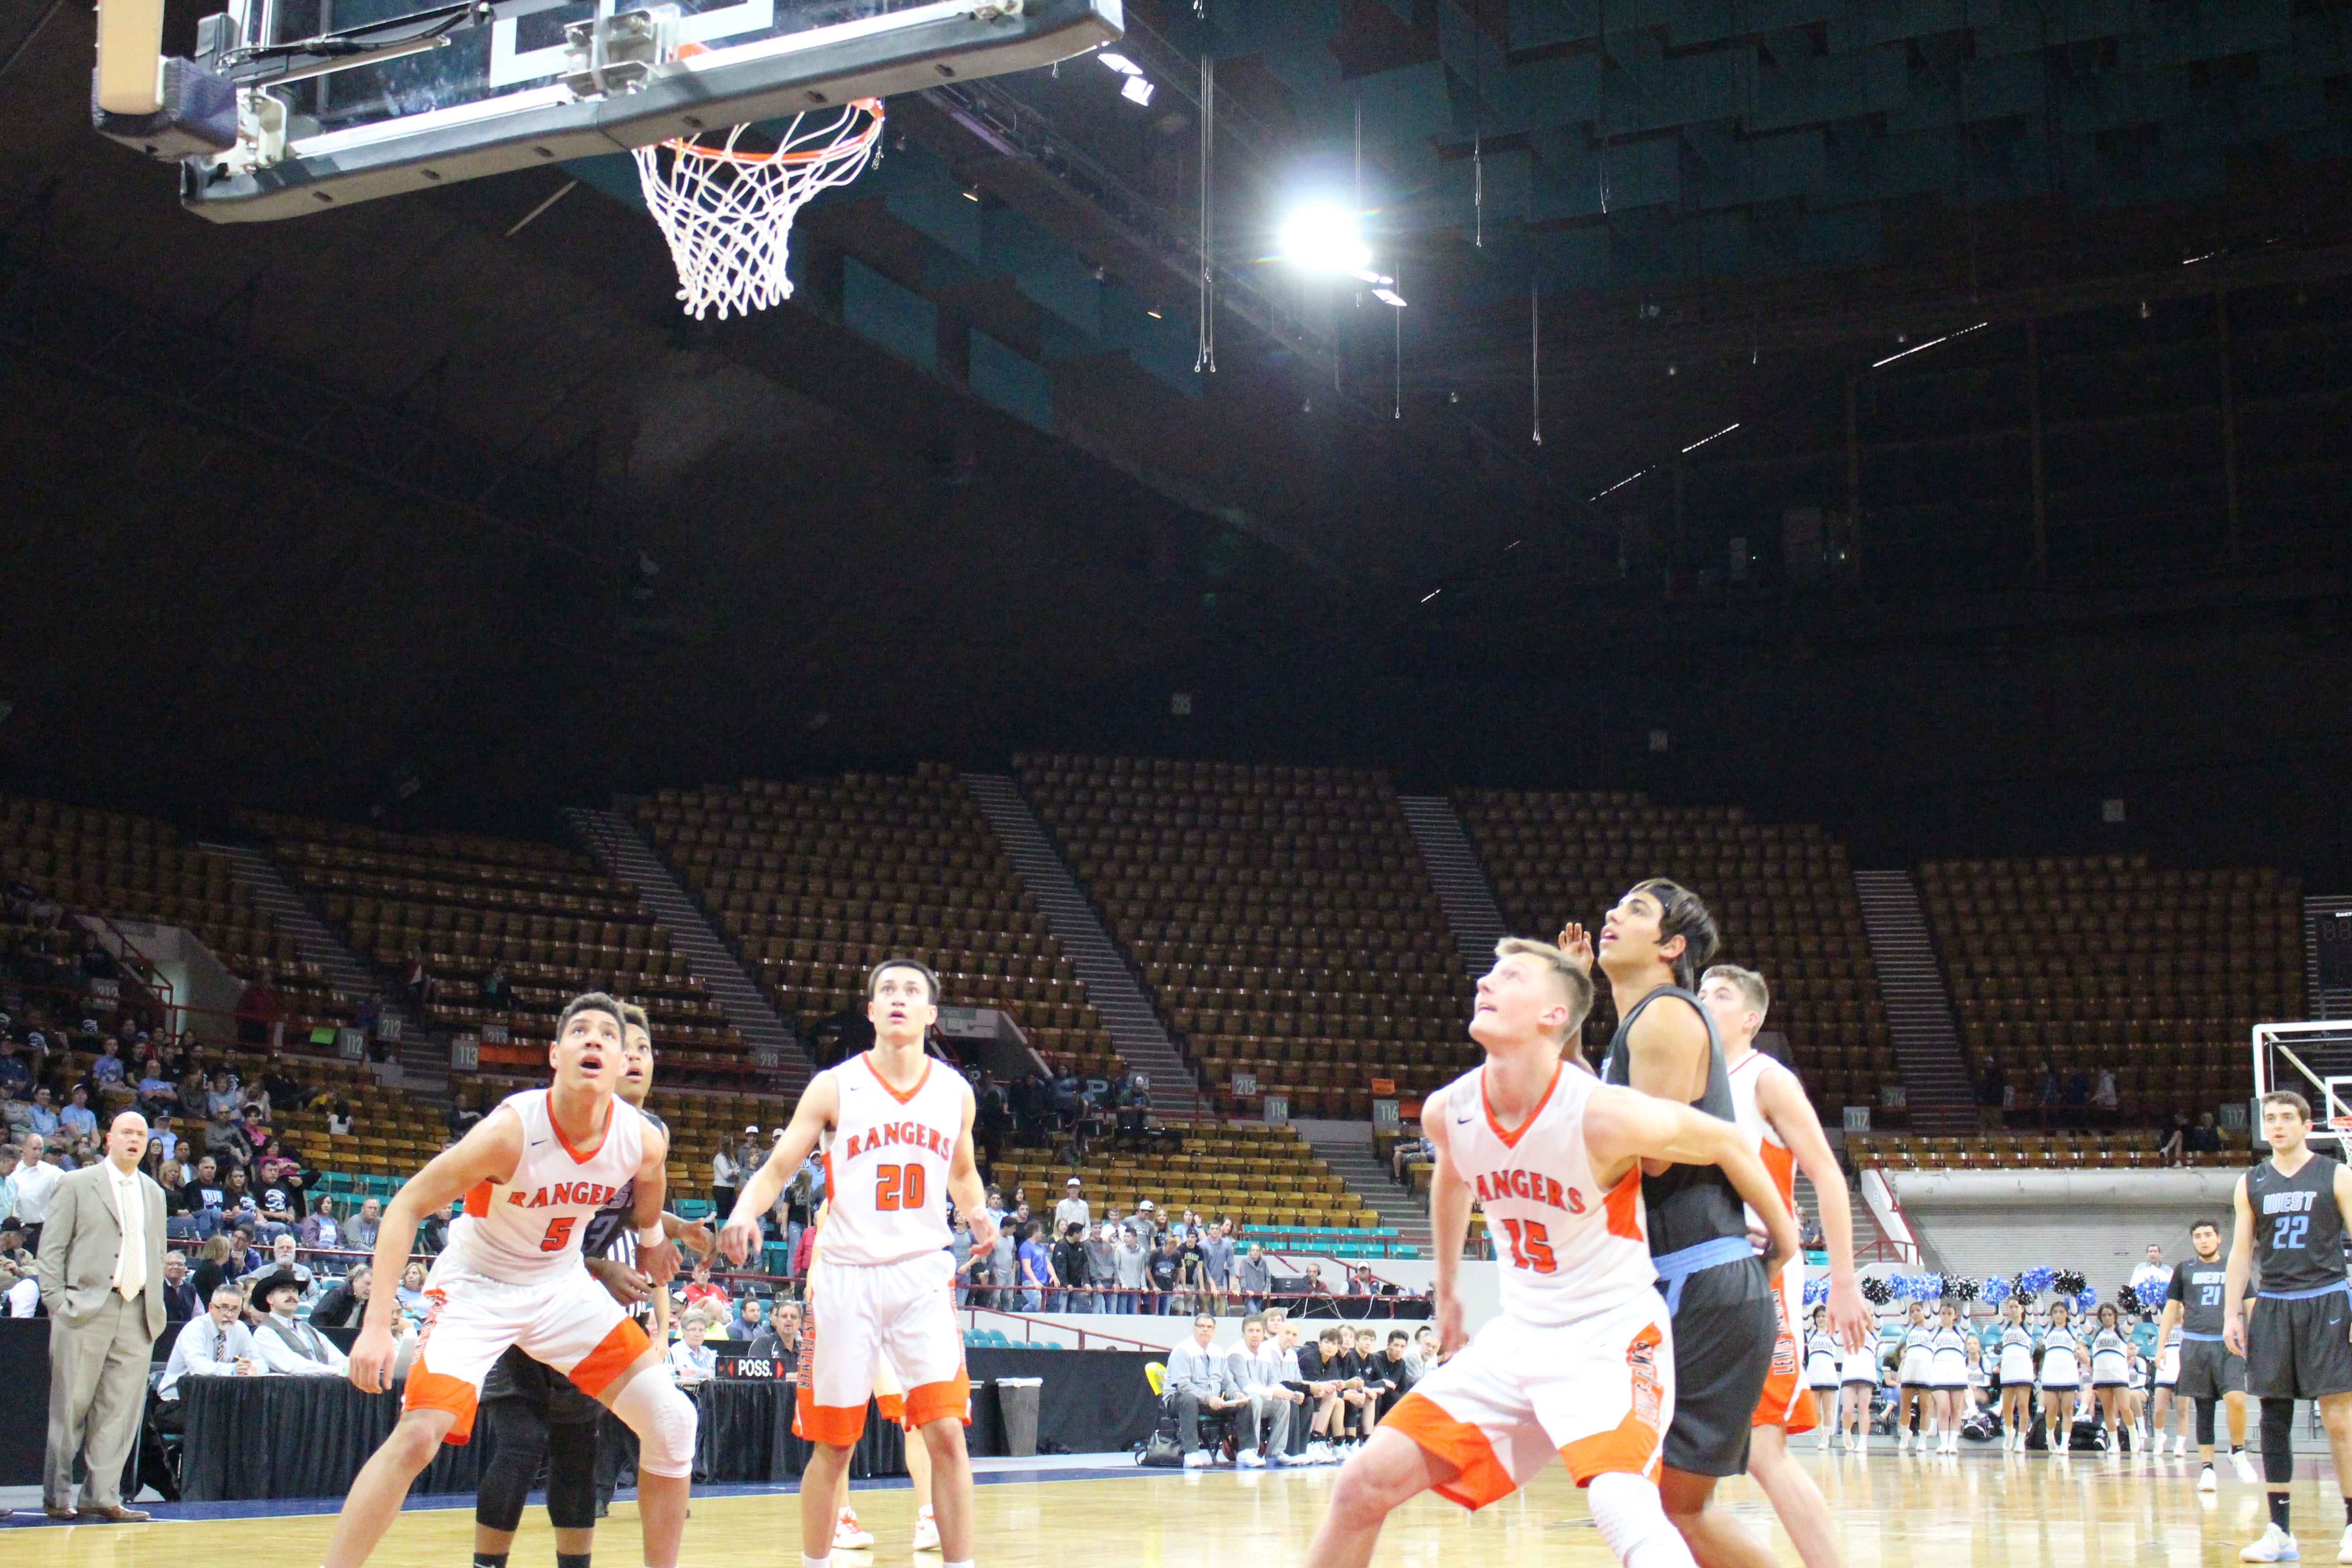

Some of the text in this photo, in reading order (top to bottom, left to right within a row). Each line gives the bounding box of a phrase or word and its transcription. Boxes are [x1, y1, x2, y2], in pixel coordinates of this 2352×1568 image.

[382, 1019, 401, 1037] 212
[347, 1035, 363, 1054] 112
[460, 1046, 479, 1065] 113
[1236, 1079, 1257, 1094] 215
[1271, 1102, 1288, 1118] 114
[1381, 1105, 1398, 1121] 116
[1851, 1112, 1868, 1127] 117
[847, 1122, 950, 1161] RANGERS
[876, 1163, 925, 1210] 20
[1465, 1170, 1586, 1215] ANGERS
[205, 1190, 223, 1203] DUB
[2263, 1191, 2317, 1215] WEST
[540, 1217, 577, 1252] 5
[2272, 1215, 2309, 1249] 22
[1500, 1218, 1558, 1274] 15
[2201, 1286, 2221, 1305] 21
[738, 1359, 773, 1377] POSS.
